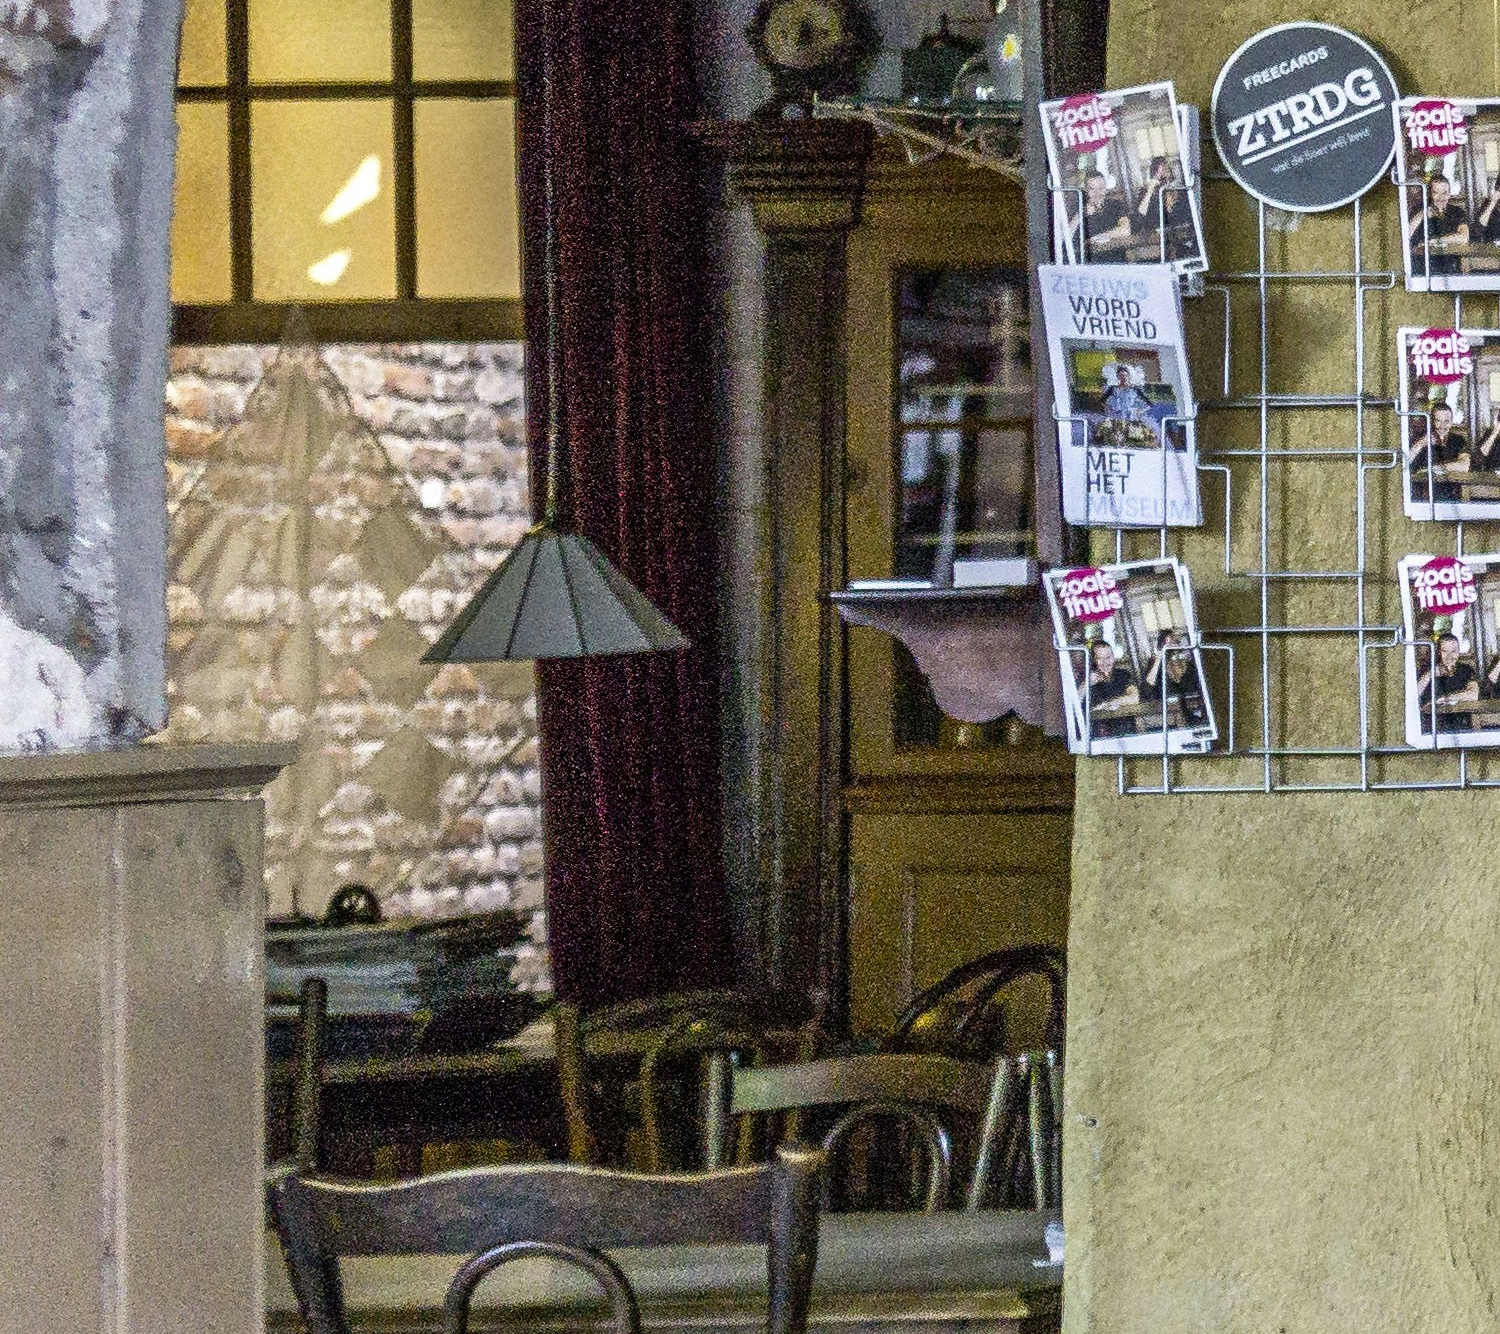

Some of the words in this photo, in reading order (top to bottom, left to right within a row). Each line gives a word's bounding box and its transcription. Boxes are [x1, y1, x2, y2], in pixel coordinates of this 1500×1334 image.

[1243, 46, 1329, 90] FREECARDS
[1055, 98, 1112, 127] zoals
[1227, 68, 1382, 156] ZTRDG
[1405, 103, 1464, 128] zoals
[1057, 118, 1118, 148] thuis
[1408, 125, 1468, 149] thuis
[1069, 296, 1141, 319] WORD
[1073, 317, 1158, 341] VRIEND
[1411, 333, 1470, 355] zoals
[1413, 353, 1473, 376] thuis
[1087, 452, 1135, 474] MET
[1087, 474, 1128, 495] HET
[1057, 569, 1116, 598] zoals
[1414, 563, 1473, 588] zoals
[1063, 591, 1124, 618] thuis
[1416, 584, 1477, 608] thuis
